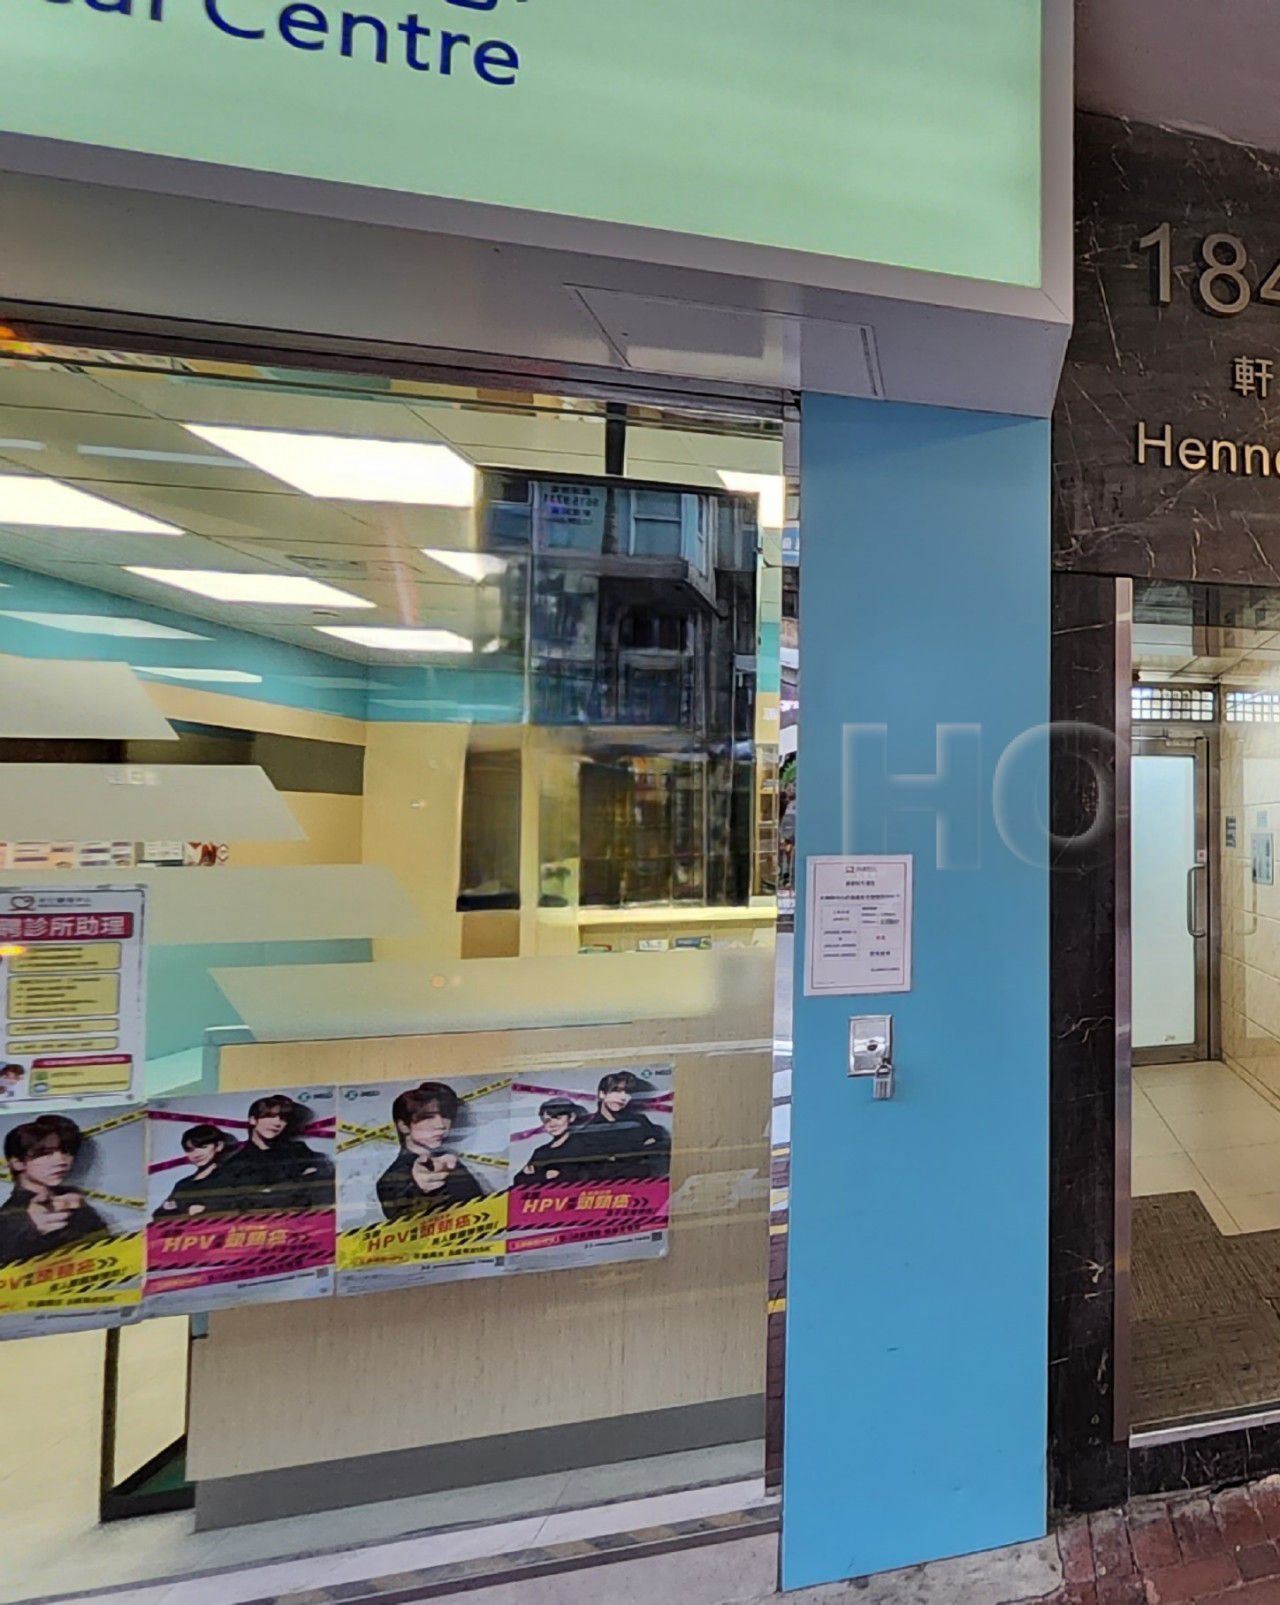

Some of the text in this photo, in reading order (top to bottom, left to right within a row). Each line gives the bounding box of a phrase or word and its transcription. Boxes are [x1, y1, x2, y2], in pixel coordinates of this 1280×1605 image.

[205, 0, 520, 85] Centre
[522, 1197, 570, 1214] HPV
[161, 1233, 216, 1252] HPV
[367, 1230, 409, 1252] HPV
